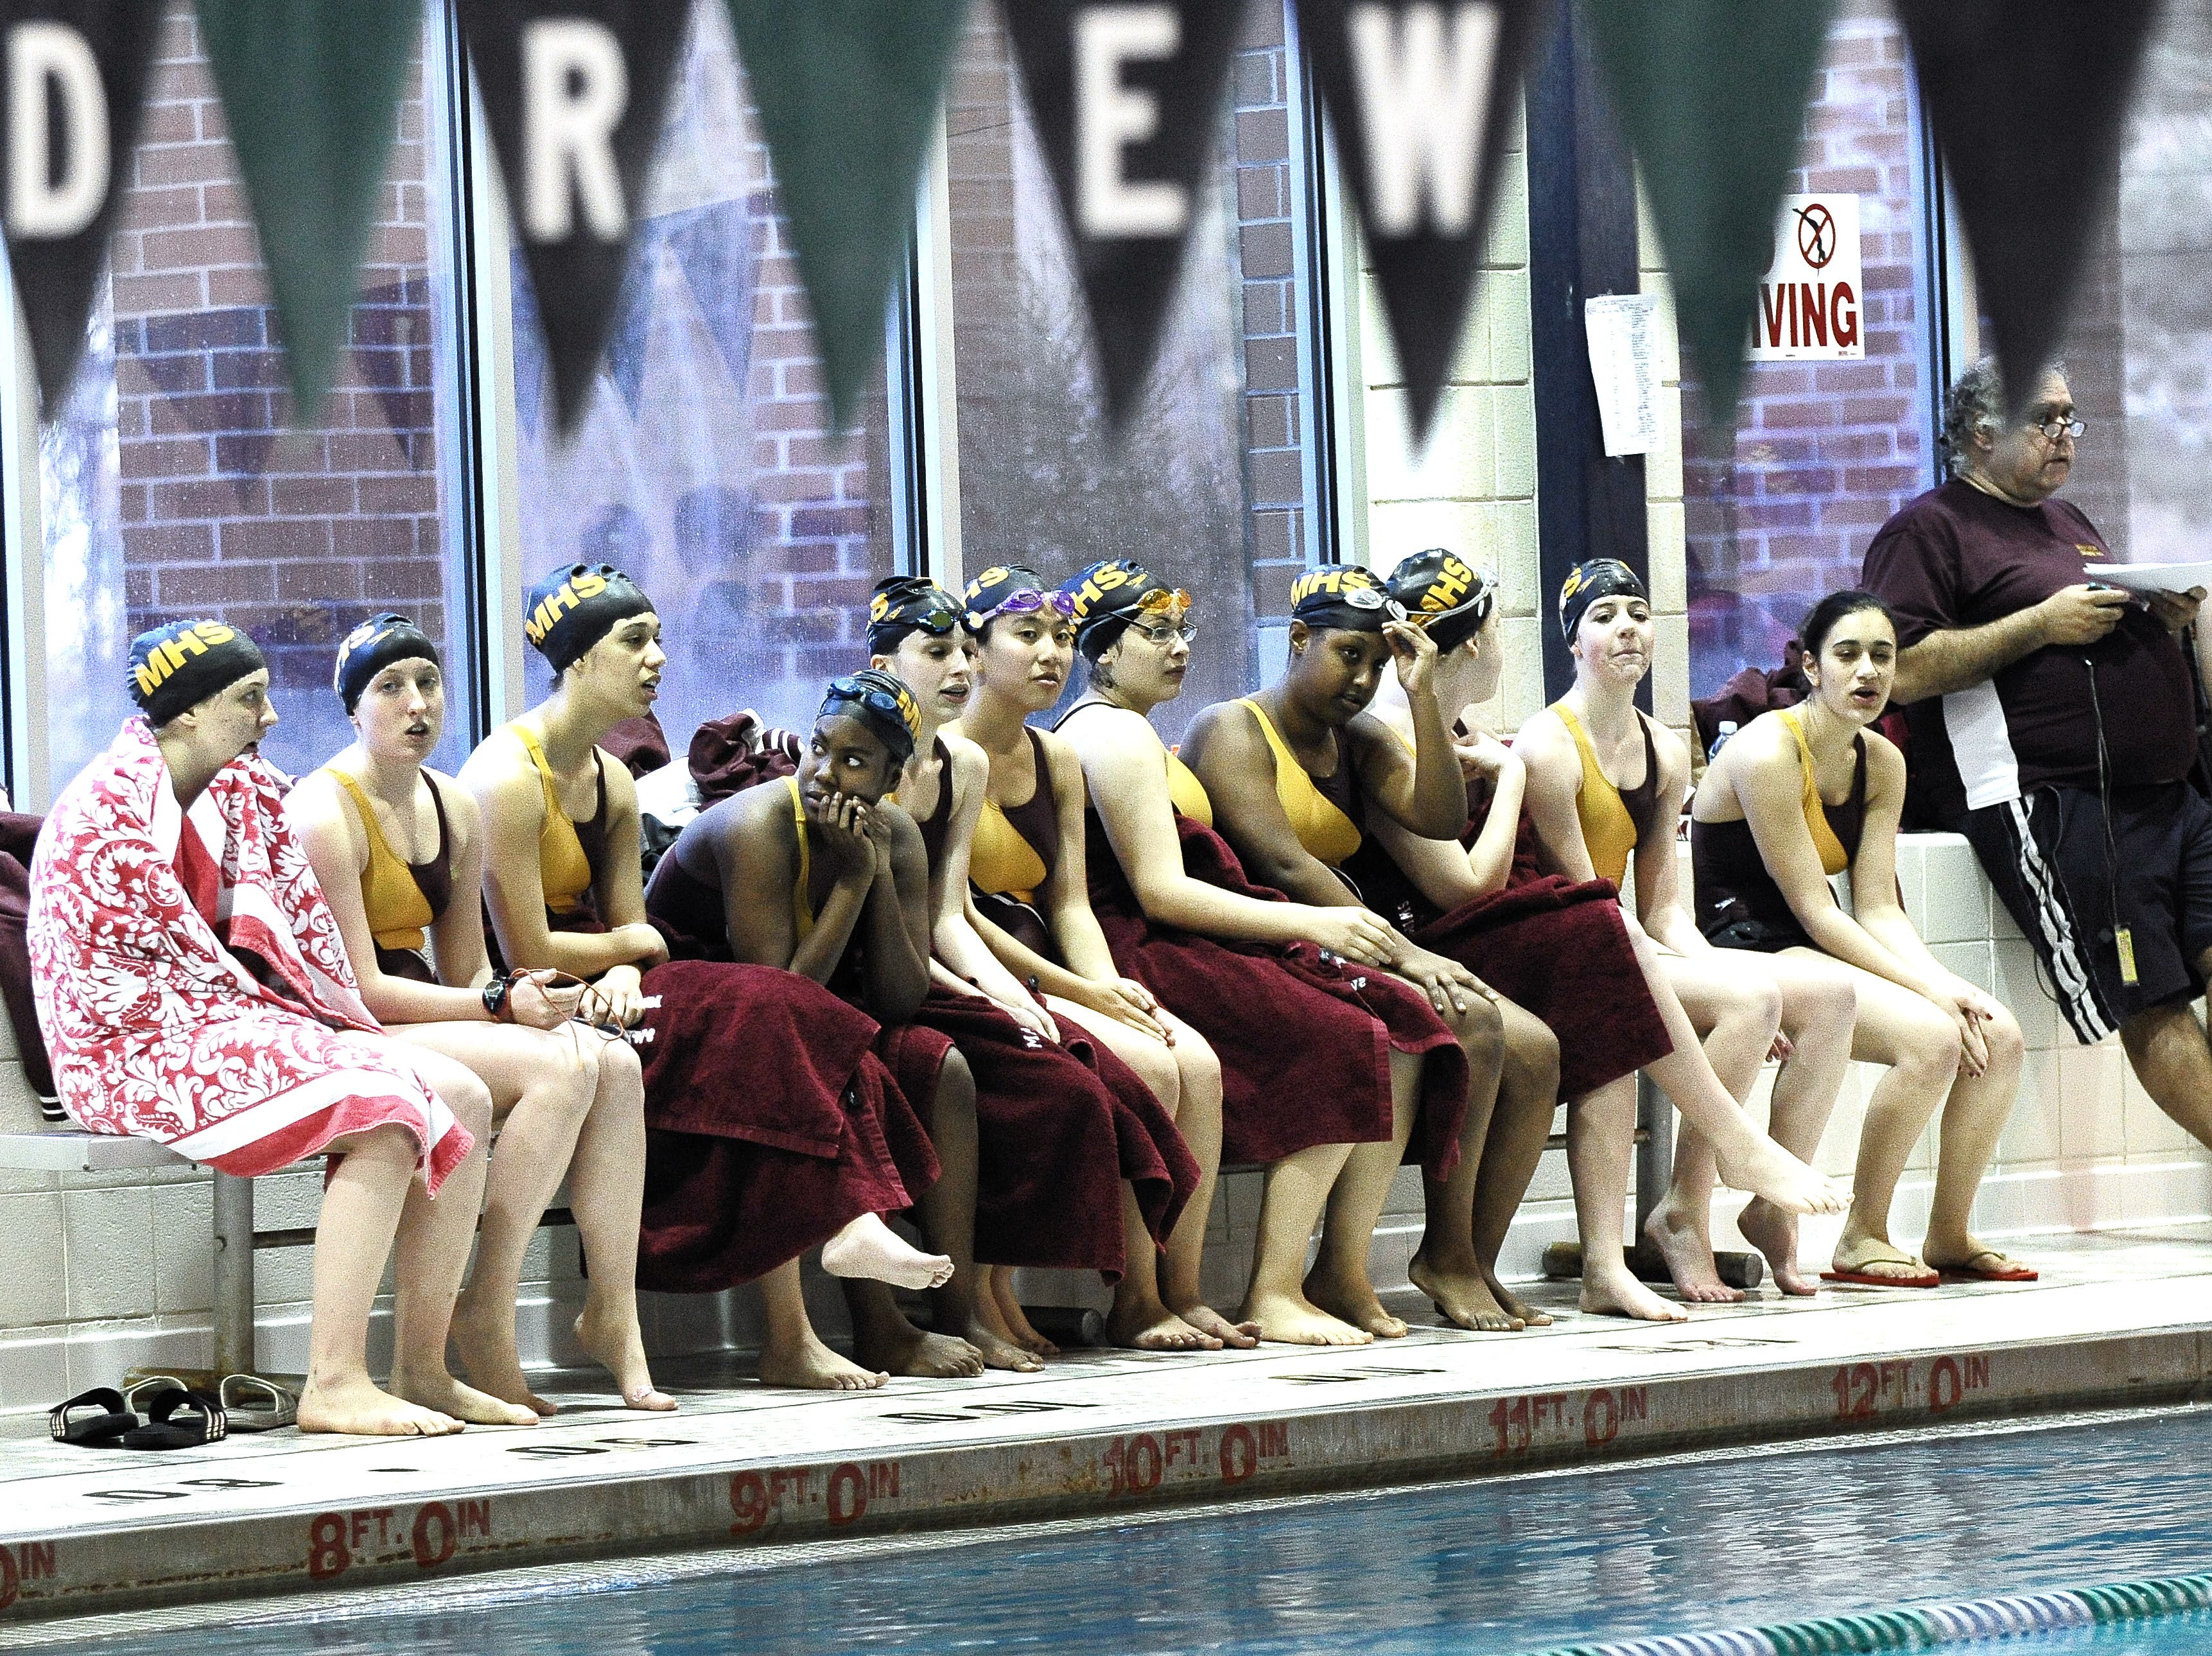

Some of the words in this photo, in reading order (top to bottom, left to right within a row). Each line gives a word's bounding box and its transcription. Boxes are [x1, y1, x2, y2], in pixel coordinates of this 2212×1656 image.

[3, 19, 112, 240] D
[520, 17, 631, 244] R
[1071, 6, 1189, 238] E
[1348, 2, 1501, 238] W
[1752, 282, 1858, 348] IVING
[525, 573, 607, 644] MHS
[1070, 564, 1128, 631] HS
[1291, 571, 1373, 609] MHS
[134, 620, 235, 697] MHS
